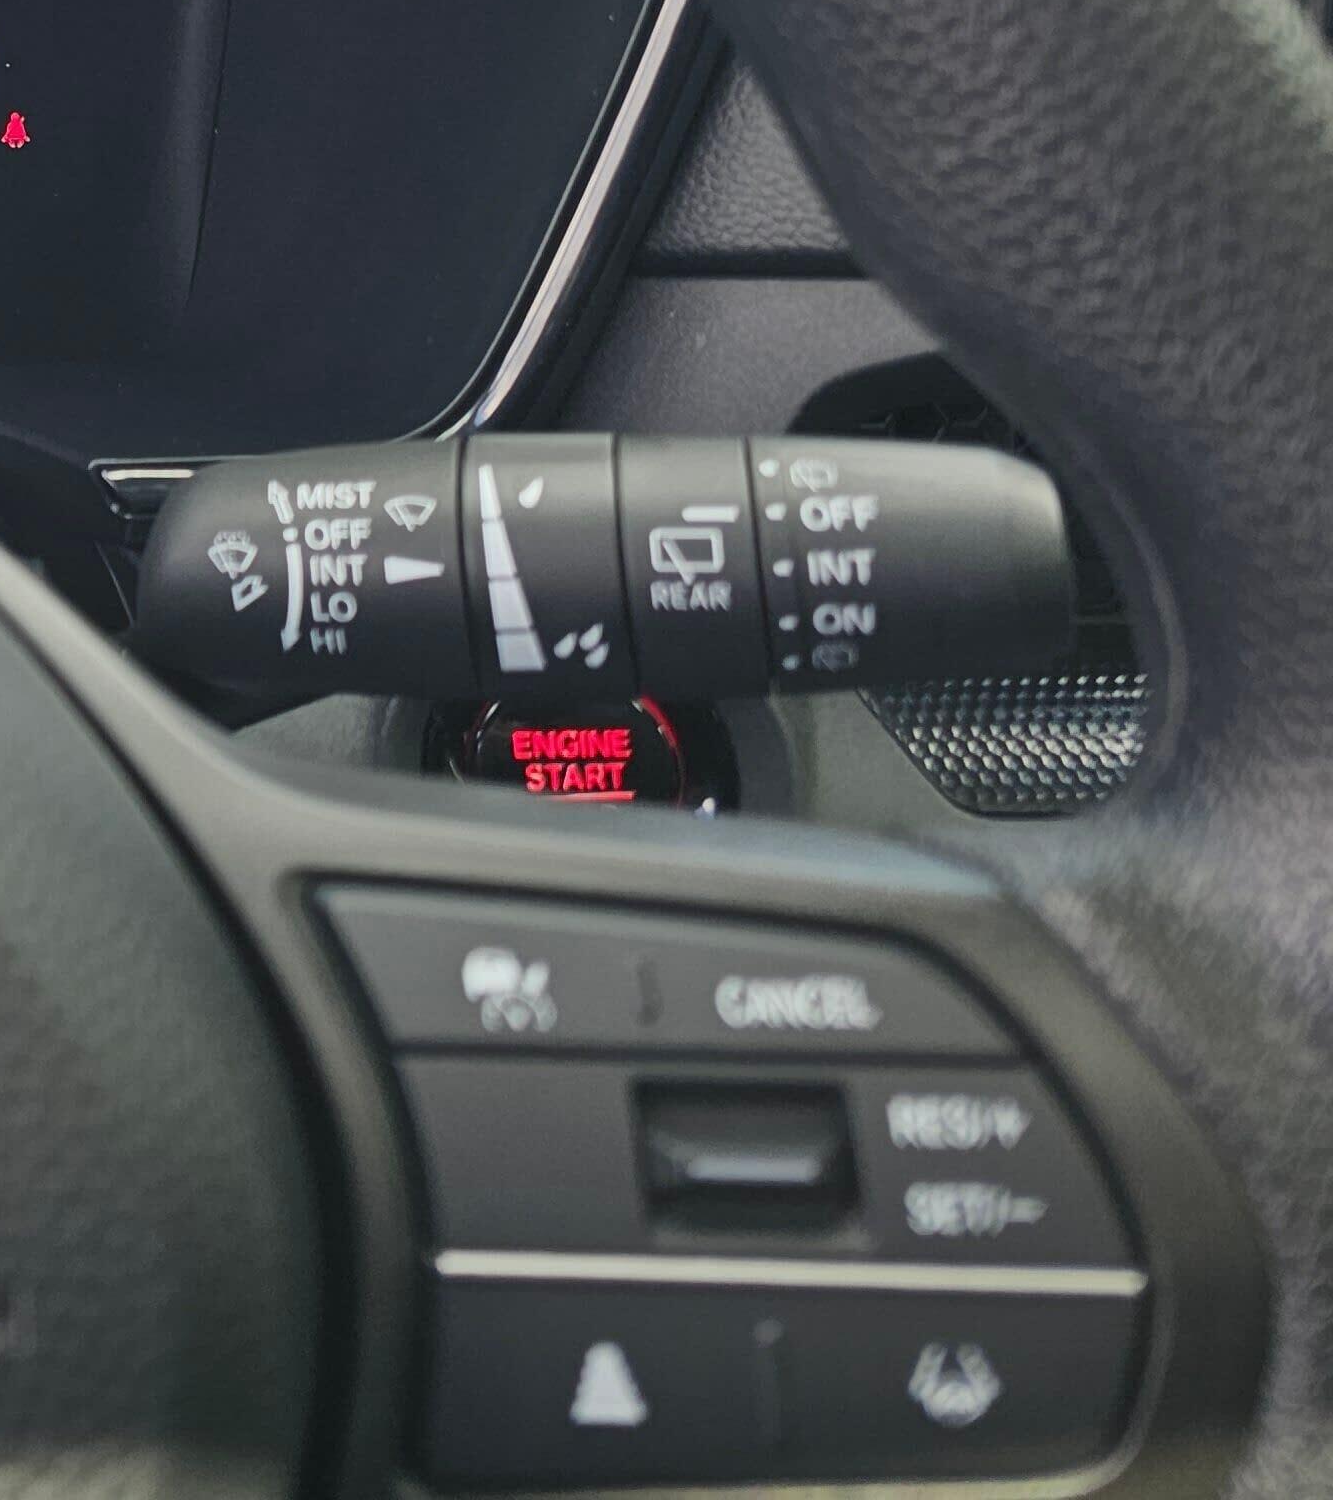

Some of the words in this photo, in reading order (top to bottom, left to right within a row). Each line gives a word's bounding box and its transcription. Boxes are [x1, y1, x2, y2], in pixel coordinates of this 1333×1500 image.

[296, 481, 375, 509] MIST
[799, 497, 879, 533] OFF
[304, 519, 371, 551] OFF
[309, 554, 368, 586] INT
[806, 549, 877, 586] INT
[310, 594, 358, 624] LO
[650, 581, 732, 612] REAR
[811, 604, 876, 636] ON
[310, 625, 347, 655] HI
[511, 728, 633, 761] ENGINE
[524, 761, 624, 793] START
[714, 975, 883, 1031] CANCEL
